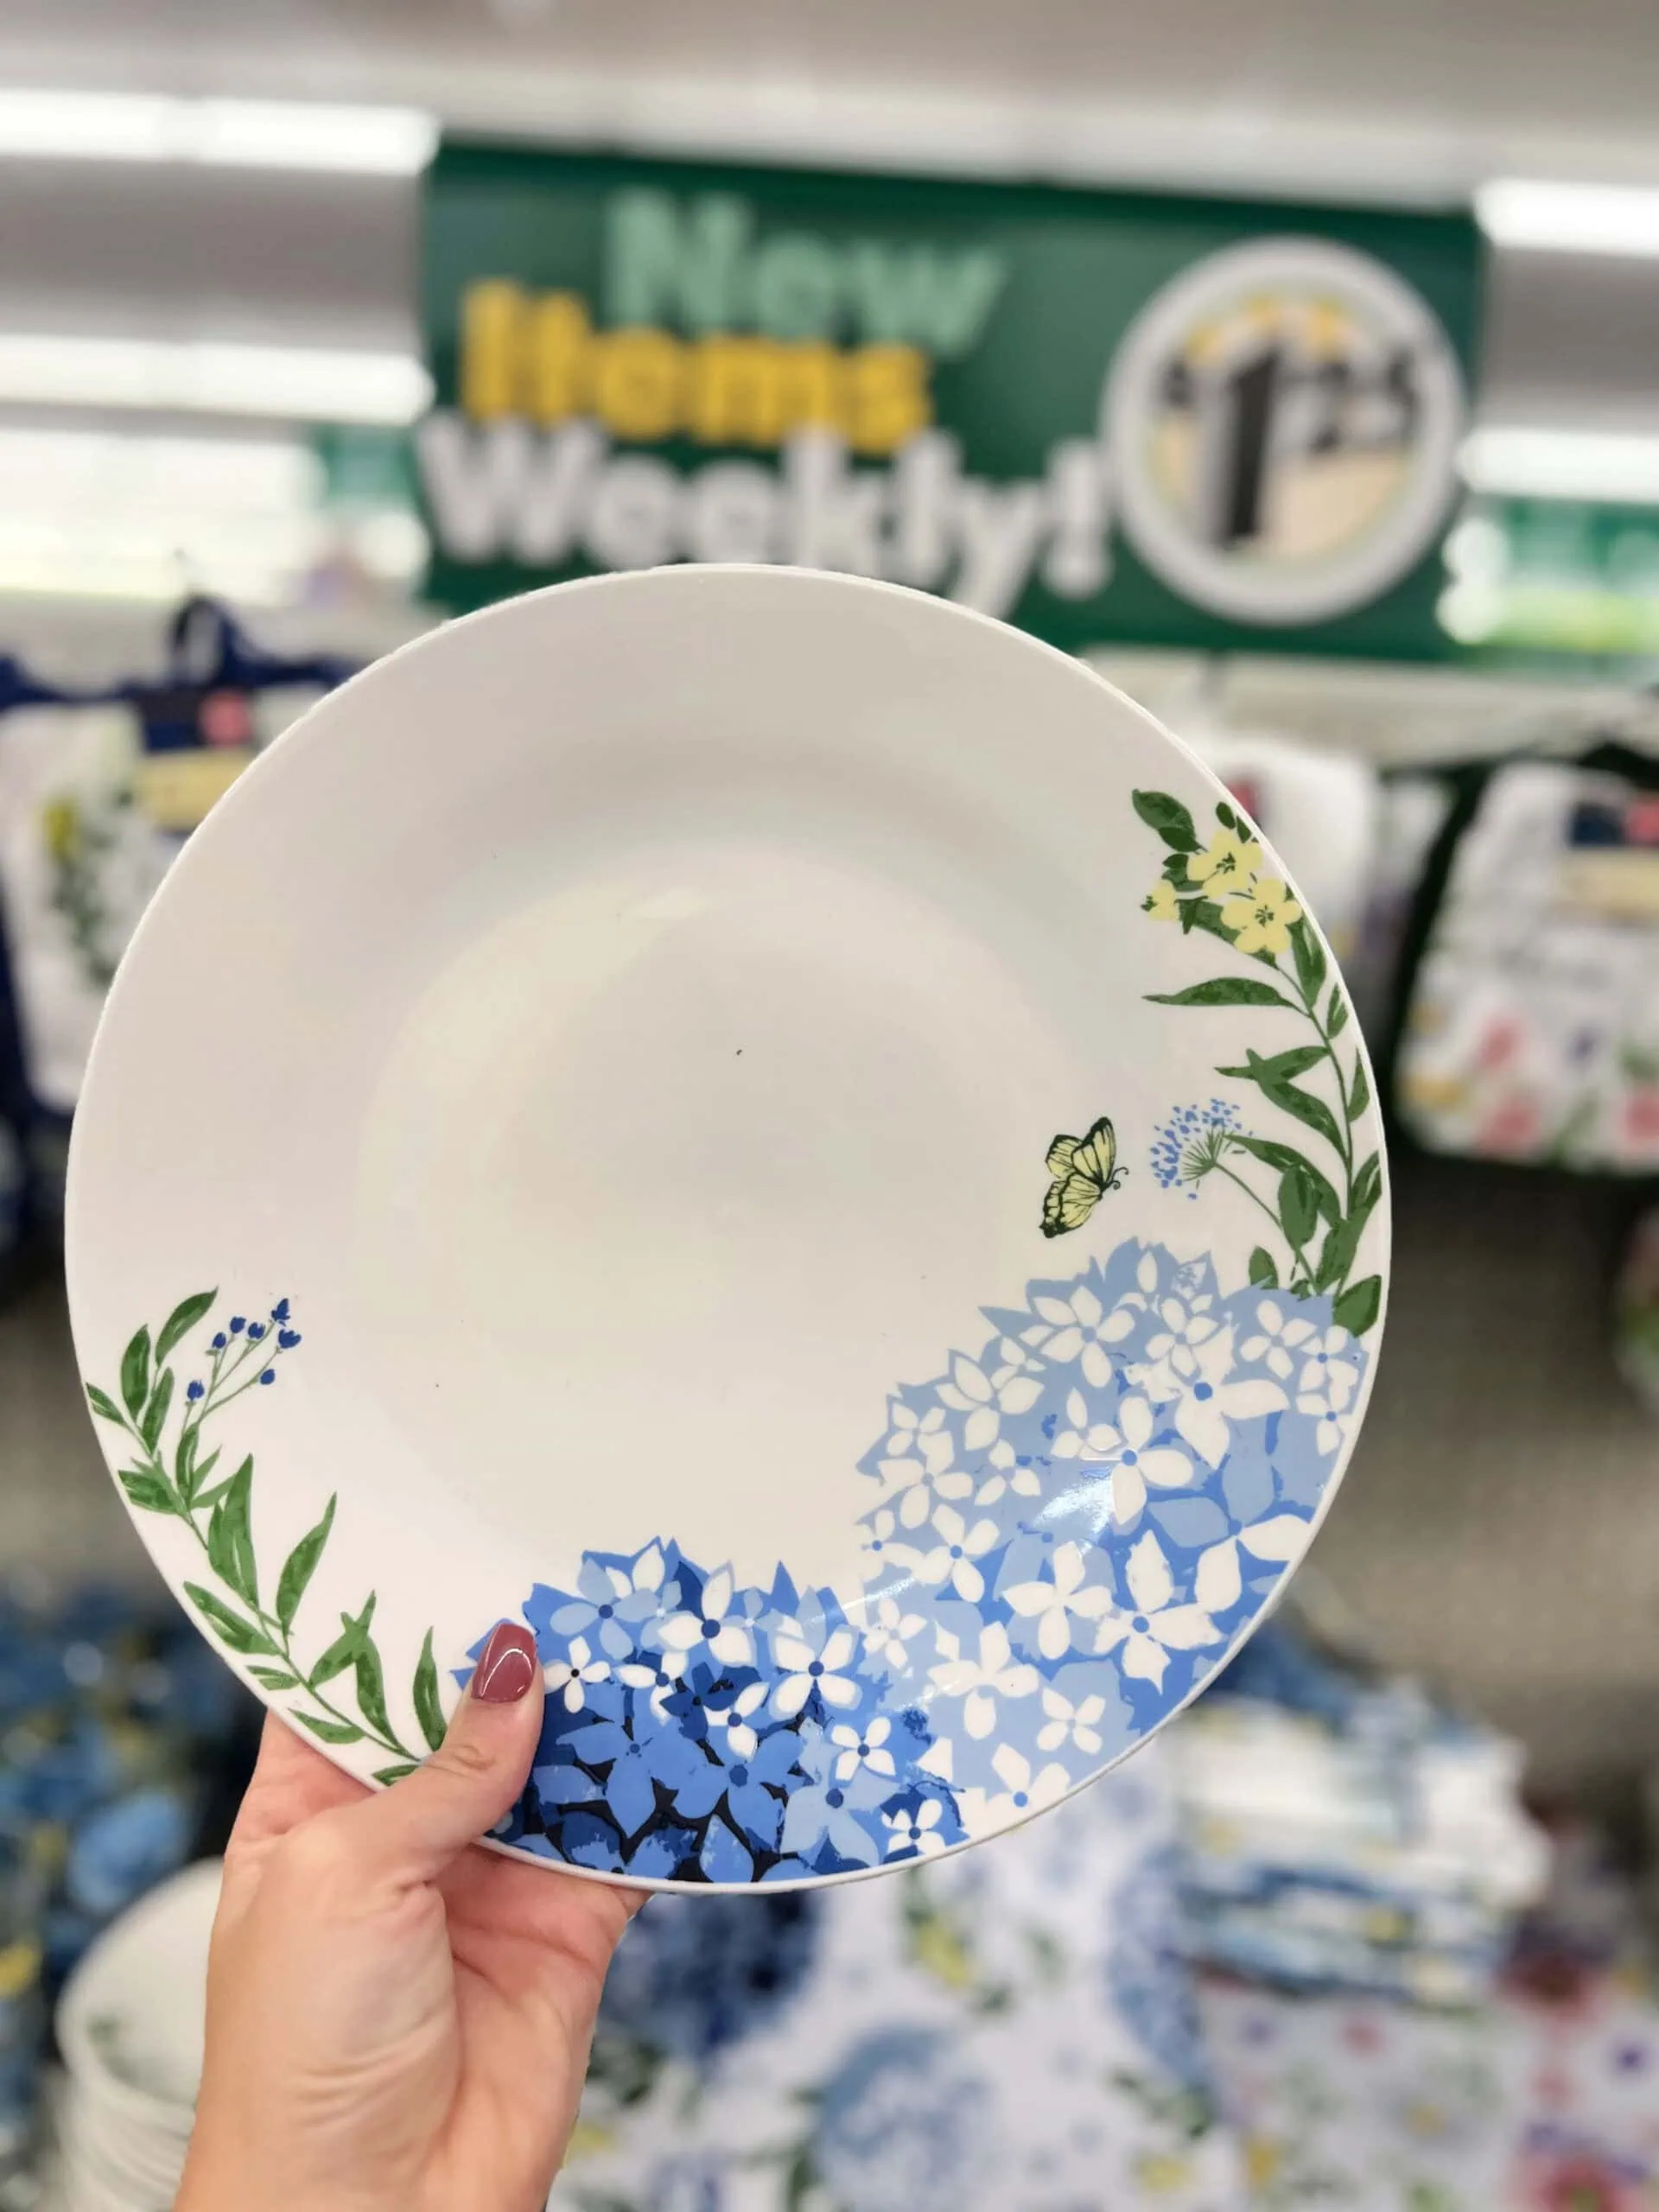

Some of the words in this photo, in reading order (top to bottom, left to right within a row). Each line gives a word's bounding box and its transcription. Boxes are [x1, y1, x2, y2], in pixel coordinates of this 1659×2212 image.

[608, 189, 1005, 355] New
[462, 281, 928, 454] Items
[417, 411, 1113, 615] Weekly!
